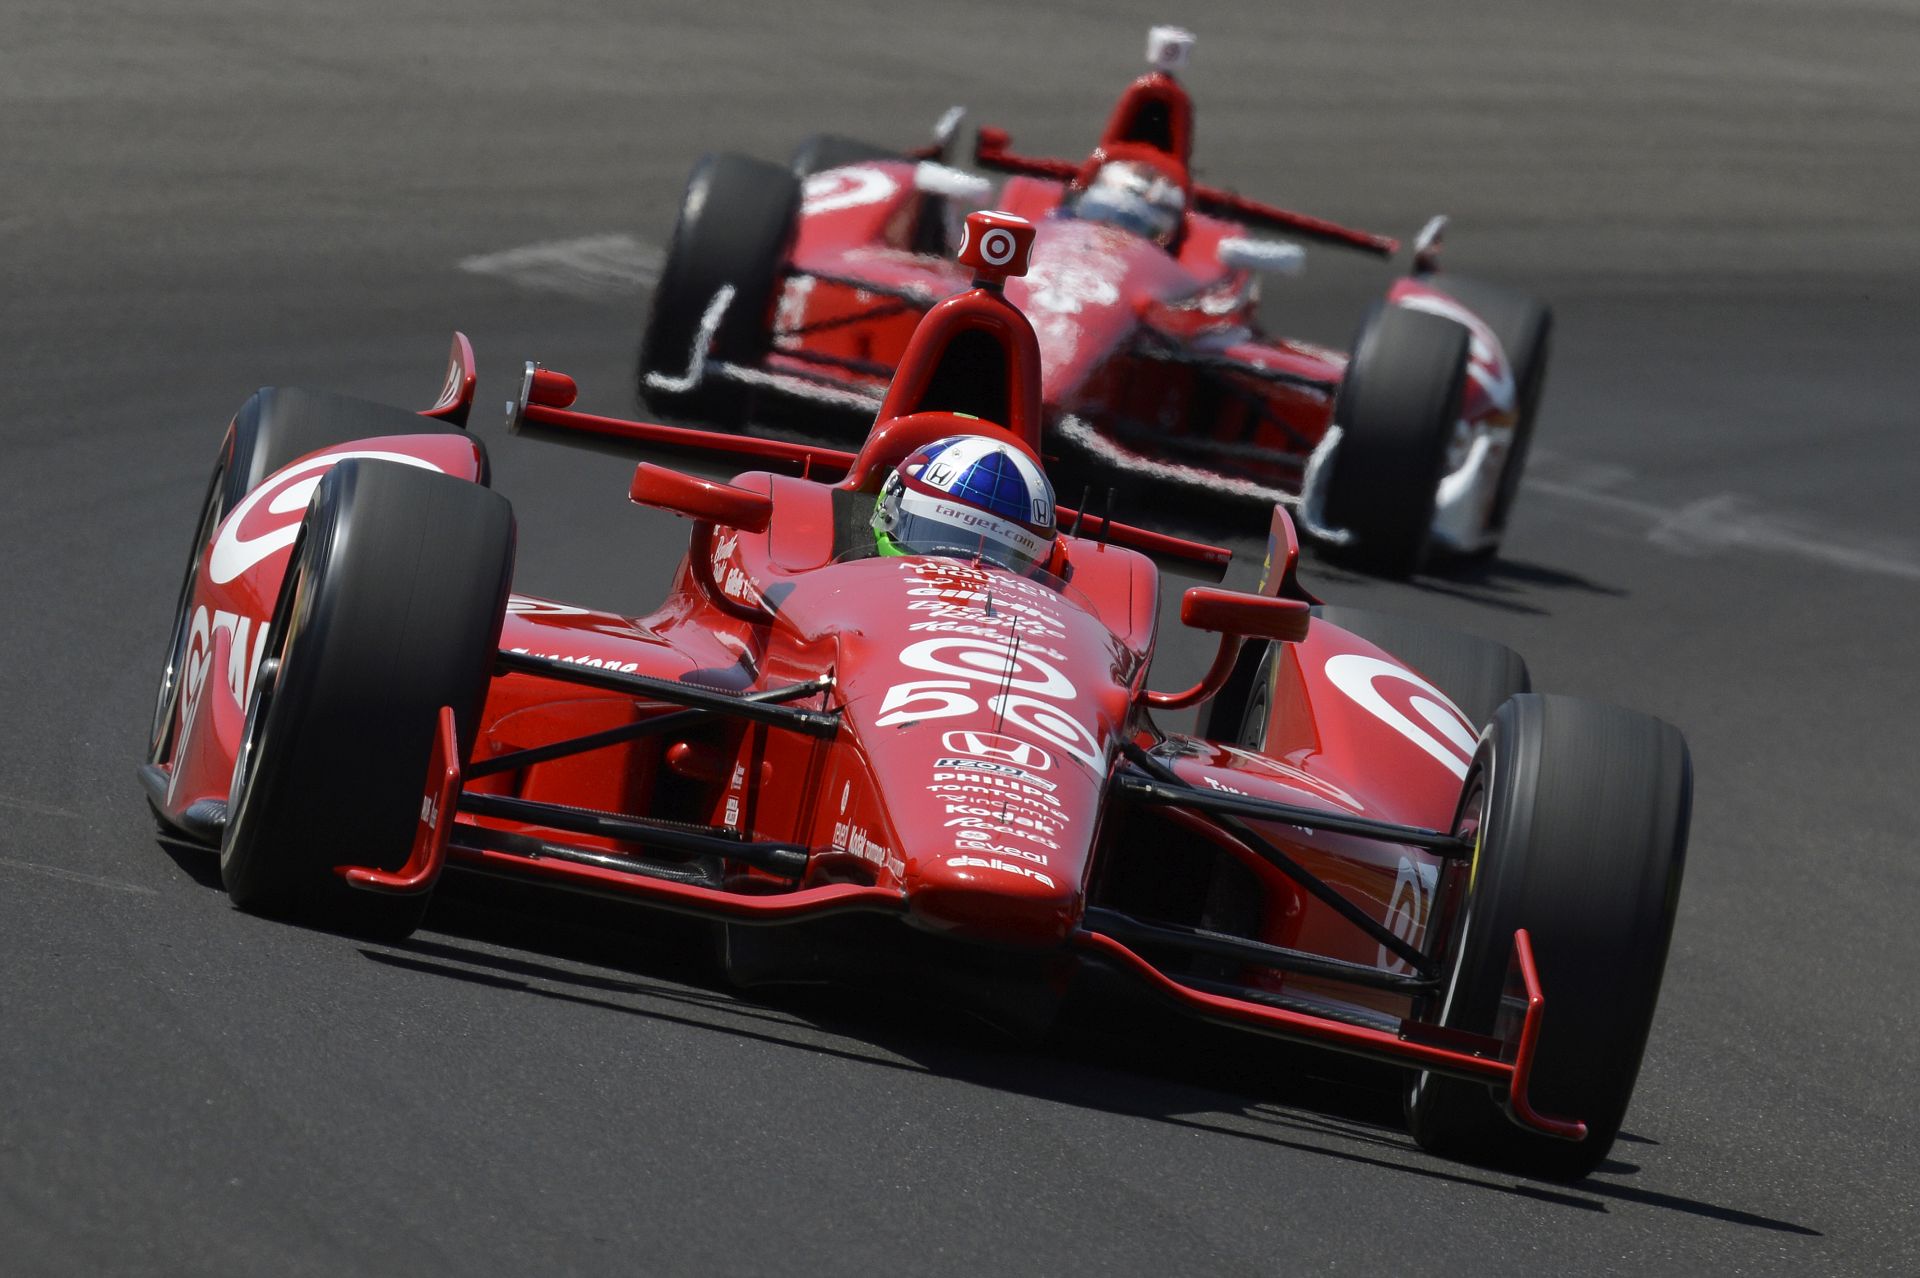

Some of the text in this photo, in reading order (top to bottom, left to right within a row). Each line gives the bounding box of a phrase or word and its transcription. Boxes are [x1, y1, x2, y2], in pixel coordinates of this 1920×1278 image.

[935, 504, 1034, 549] target.com
[899, 562, 1057, 602] Maxwell
[939, 759, 1024, 776] IZOD
[933, 773, 1061, 807] PHILIPS
[945, 804, 1055, 836] Kodak
[955, 839, 1048, 864] reveal
[946, 855, 1055, 888] dallara
